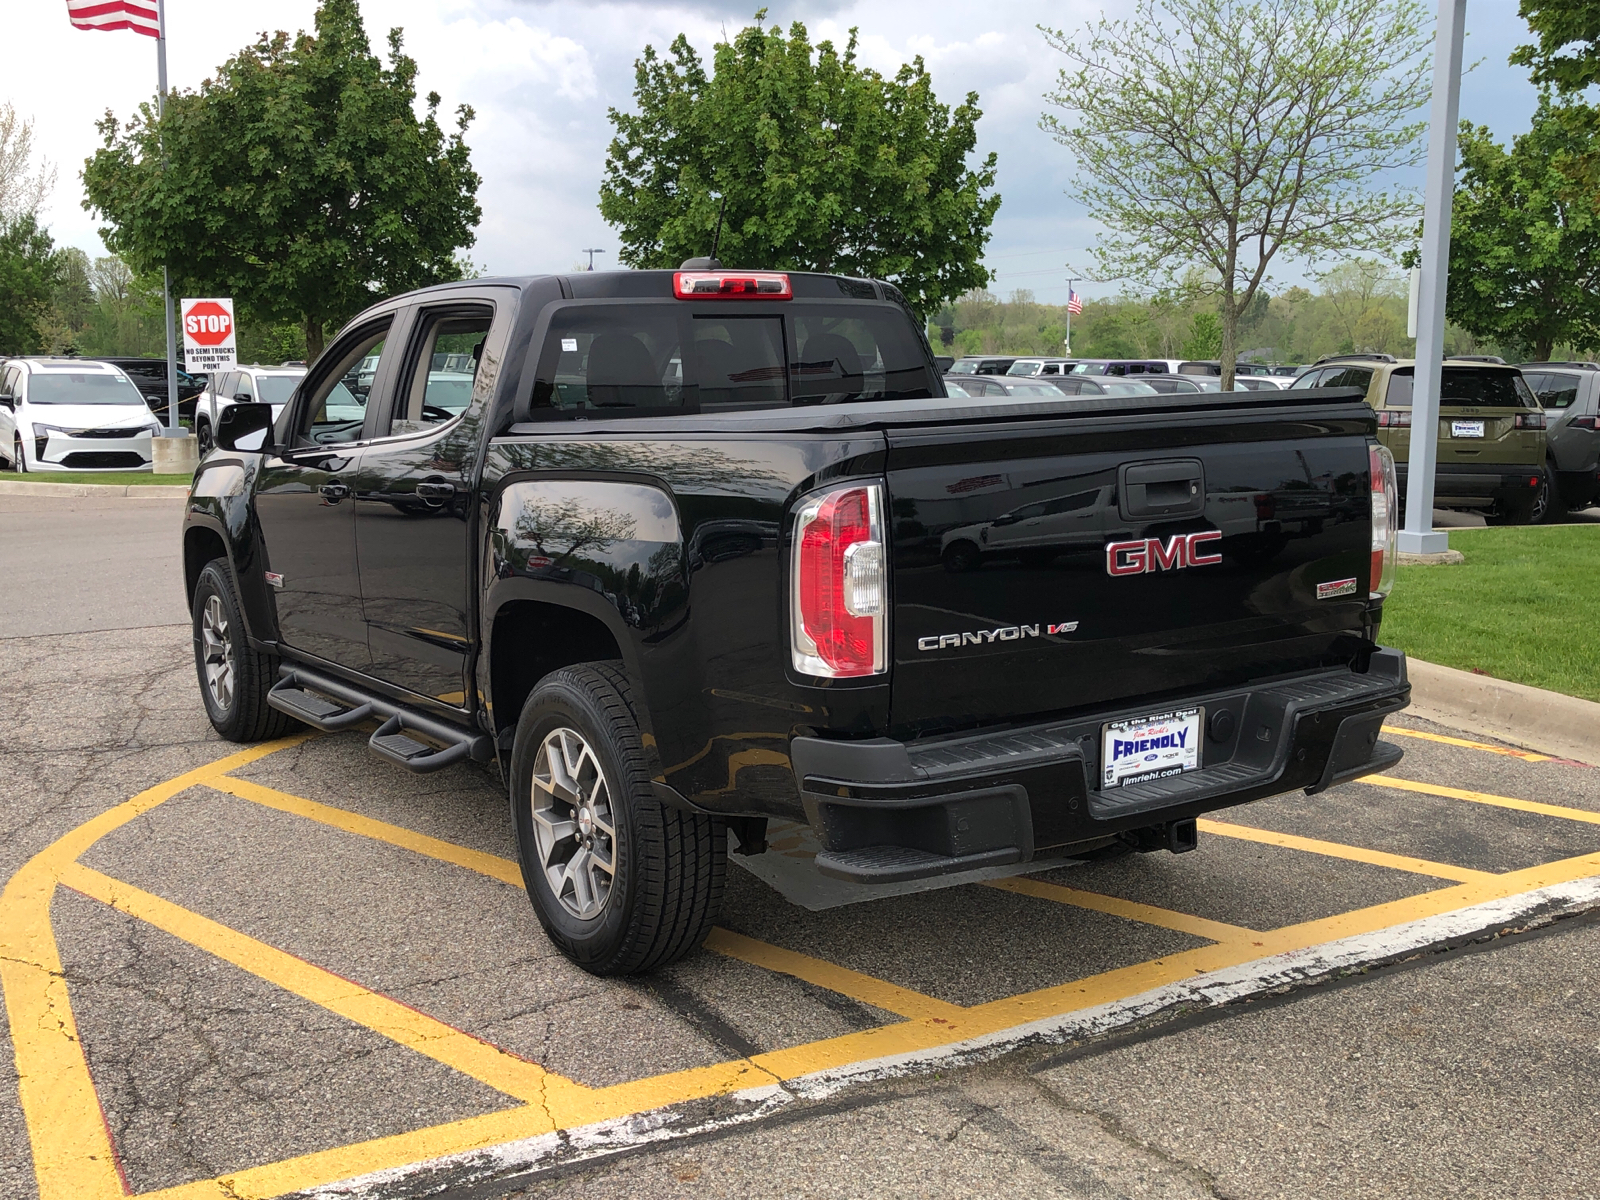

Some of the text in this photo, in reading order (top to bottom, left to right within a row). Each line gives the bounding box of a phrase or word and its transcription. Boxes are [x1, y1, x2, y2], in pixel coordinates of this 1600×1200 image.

[187, 315, 230, 333] STOP
[1106, 530, 1222, 576] GMC
[917, 621, 1079, 651] CANYON V6
[1176, 708, 1196, 717] Deal
[1113, 726, 1189, 762] FRIENDLY
[1133, 730, 1146, 740] Jim
[1122, 768, 1182, 787] jimriehl.com
[616, 824, 627, 907] KUMHO
